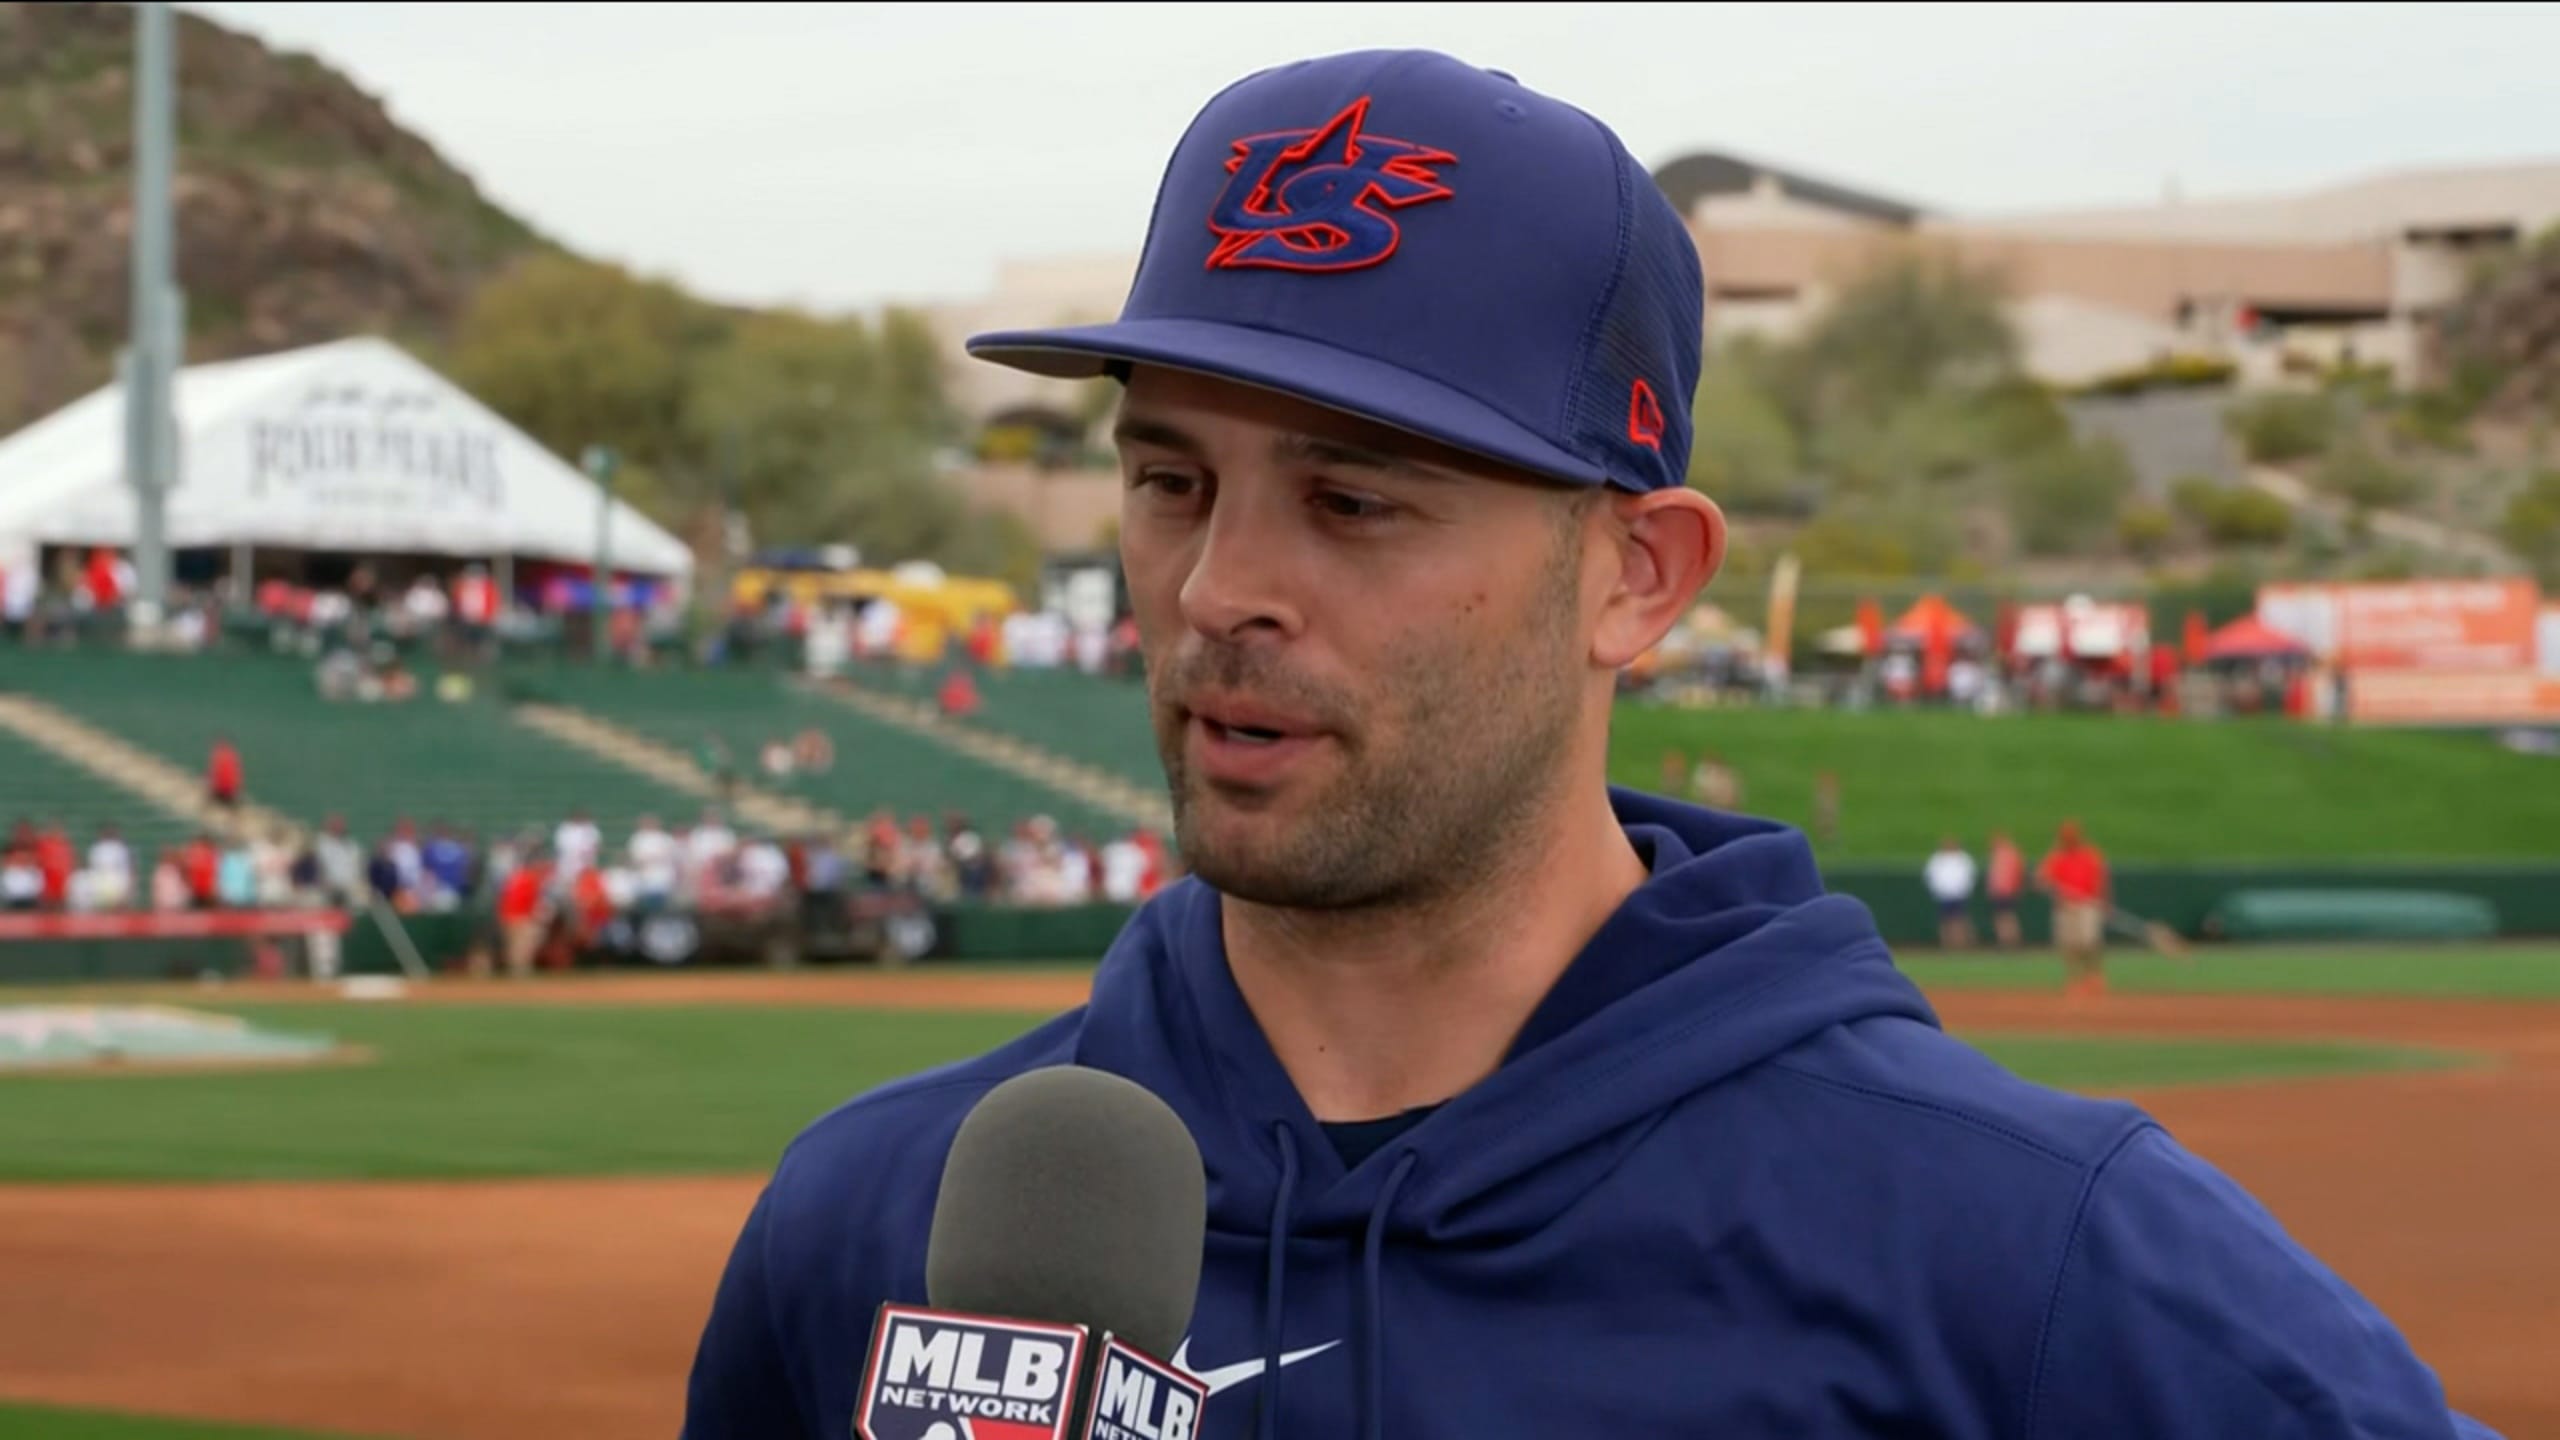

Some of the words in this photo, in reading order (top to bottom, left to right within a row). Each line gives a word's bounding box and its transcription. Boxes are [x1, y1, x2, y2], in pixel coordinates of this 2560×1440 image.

[886, 1325, 1064, 1401] MLB
[1100, 1356, 1195, 1440] MLB
[881, 1386, 1052, 1424] NETWORK
